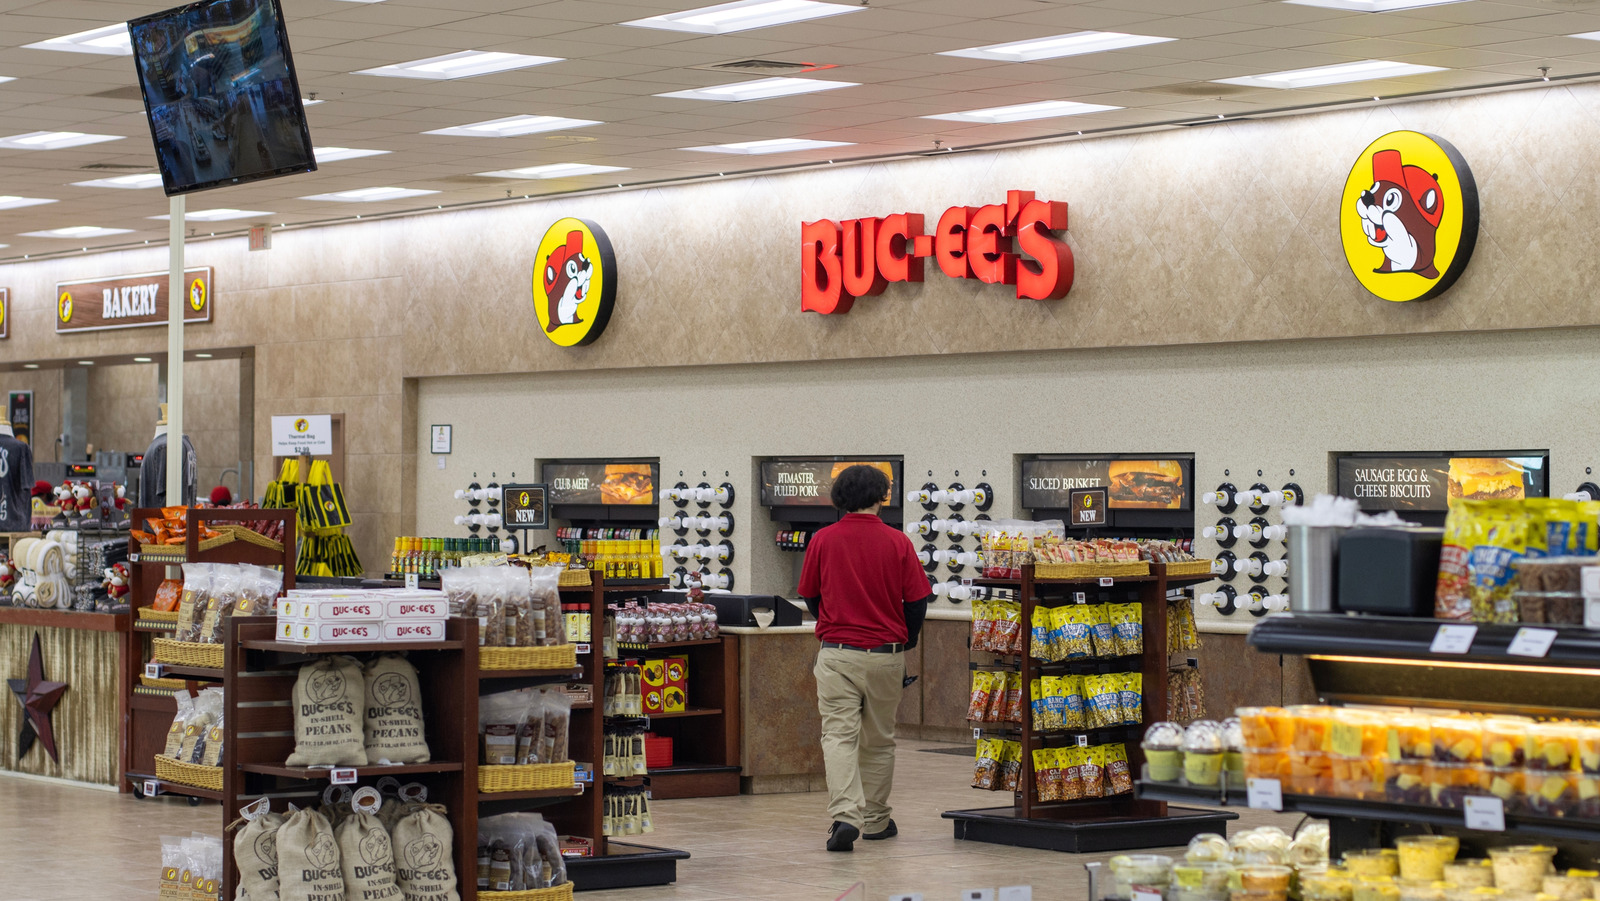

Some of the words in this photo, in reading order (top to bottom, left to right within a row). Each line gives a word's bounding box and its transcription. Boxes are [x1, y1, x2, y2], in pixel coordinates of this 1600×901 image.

[102, 283, 159, 319] BAKERY
[778, 472, 815, 484] PITMASTER
[1354, 468, 1395, 483] SAUSAGE
[1397, 468, 1418, 483] EGG
[1420, 468, 1429, 483] &
[554, 478, 571, 490] CLUB
[571, 478, 590, 490] MELT
[1029, 477, 1060, 490] SLICED
[1062, 477, 1101, 490] BRISKET
[774, 485, 798, 497] PULLED
[799, 485, 819, 497] PORK
[1353, 484, 1388, 498] CHEESE
[1389, 484, 1431, 498] BISCUITS
[515, 509, 535, 523] NEW
[1079, 510, 1097, 522] NEW
[310, 714, 345, 724] IN-SHELL
[306, 724, 352, 736] PECANS
[372, 728, 419, 738] PECANS
[410, 884, 443, 892] IN-SHELL
